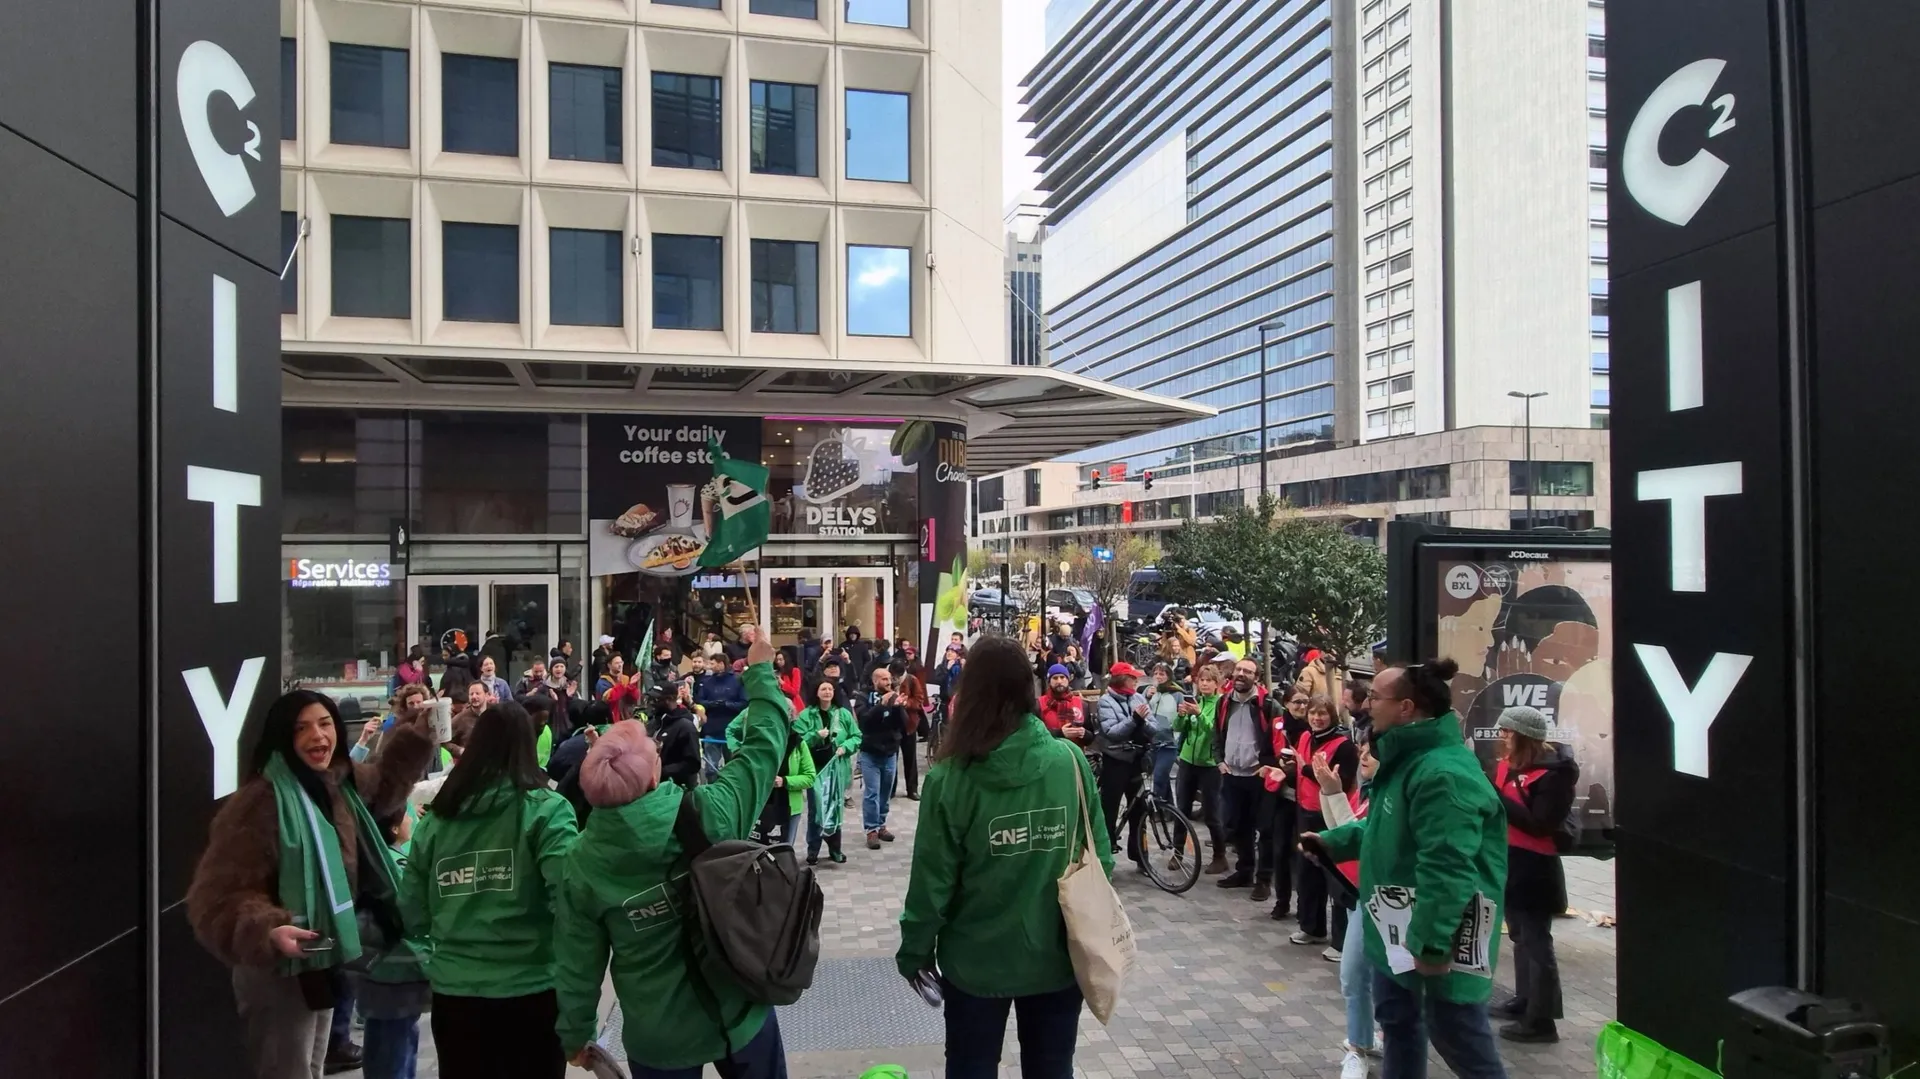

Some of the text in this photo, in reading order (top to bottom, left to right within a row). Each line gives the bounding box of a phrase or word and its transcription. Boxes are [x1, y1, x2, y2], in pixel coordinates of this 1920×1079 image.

[623, 425, 726, 446] Your daily
[619, 446, 684, 464] coffee
[806, 506, 877, 526] DELYS
[818, 526, 865, 537] STATION
[1508, 551, 1549, 559] JCDecaux
[290, 558, 390, 579] iServices
[1452, 582, 1473, 590] BXL
[1502, 684, 1548, 706] WE
[989, 827, 1028, 846] CNE
[437, 866, 475, 886] CNE
[627, 900, 669, 921] CNE
